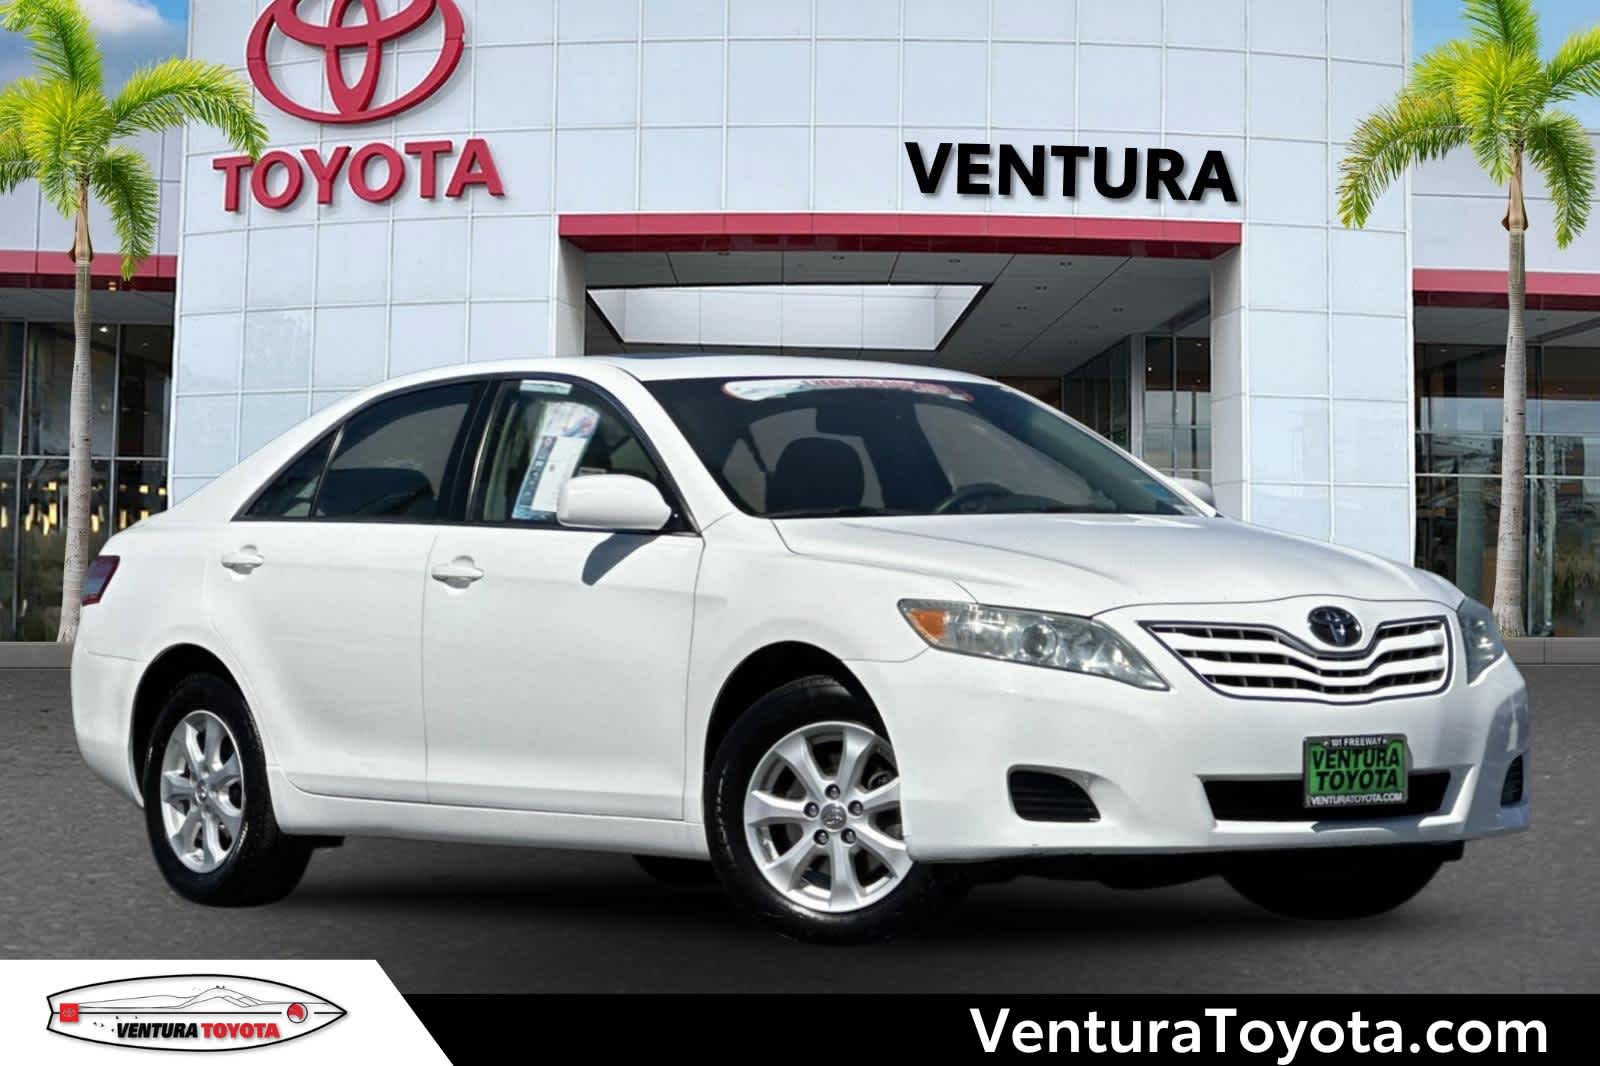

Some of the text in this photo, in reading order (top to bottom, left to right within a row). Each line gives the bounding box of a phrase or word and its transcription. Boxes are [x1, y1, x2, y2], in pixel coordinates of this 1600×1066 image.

[213, 139, 504, 211] TOYOTA
[905, 142, 1239, 202] VENTURA
[1344, 737, 1383, 746] FREEWAY
[1312, 748, 1400, 769] VENTURA
[1316, 769, 1398, 791] TOYOTA
[1311, 792, 1402, 805] VENTURATOYOTA.COM
